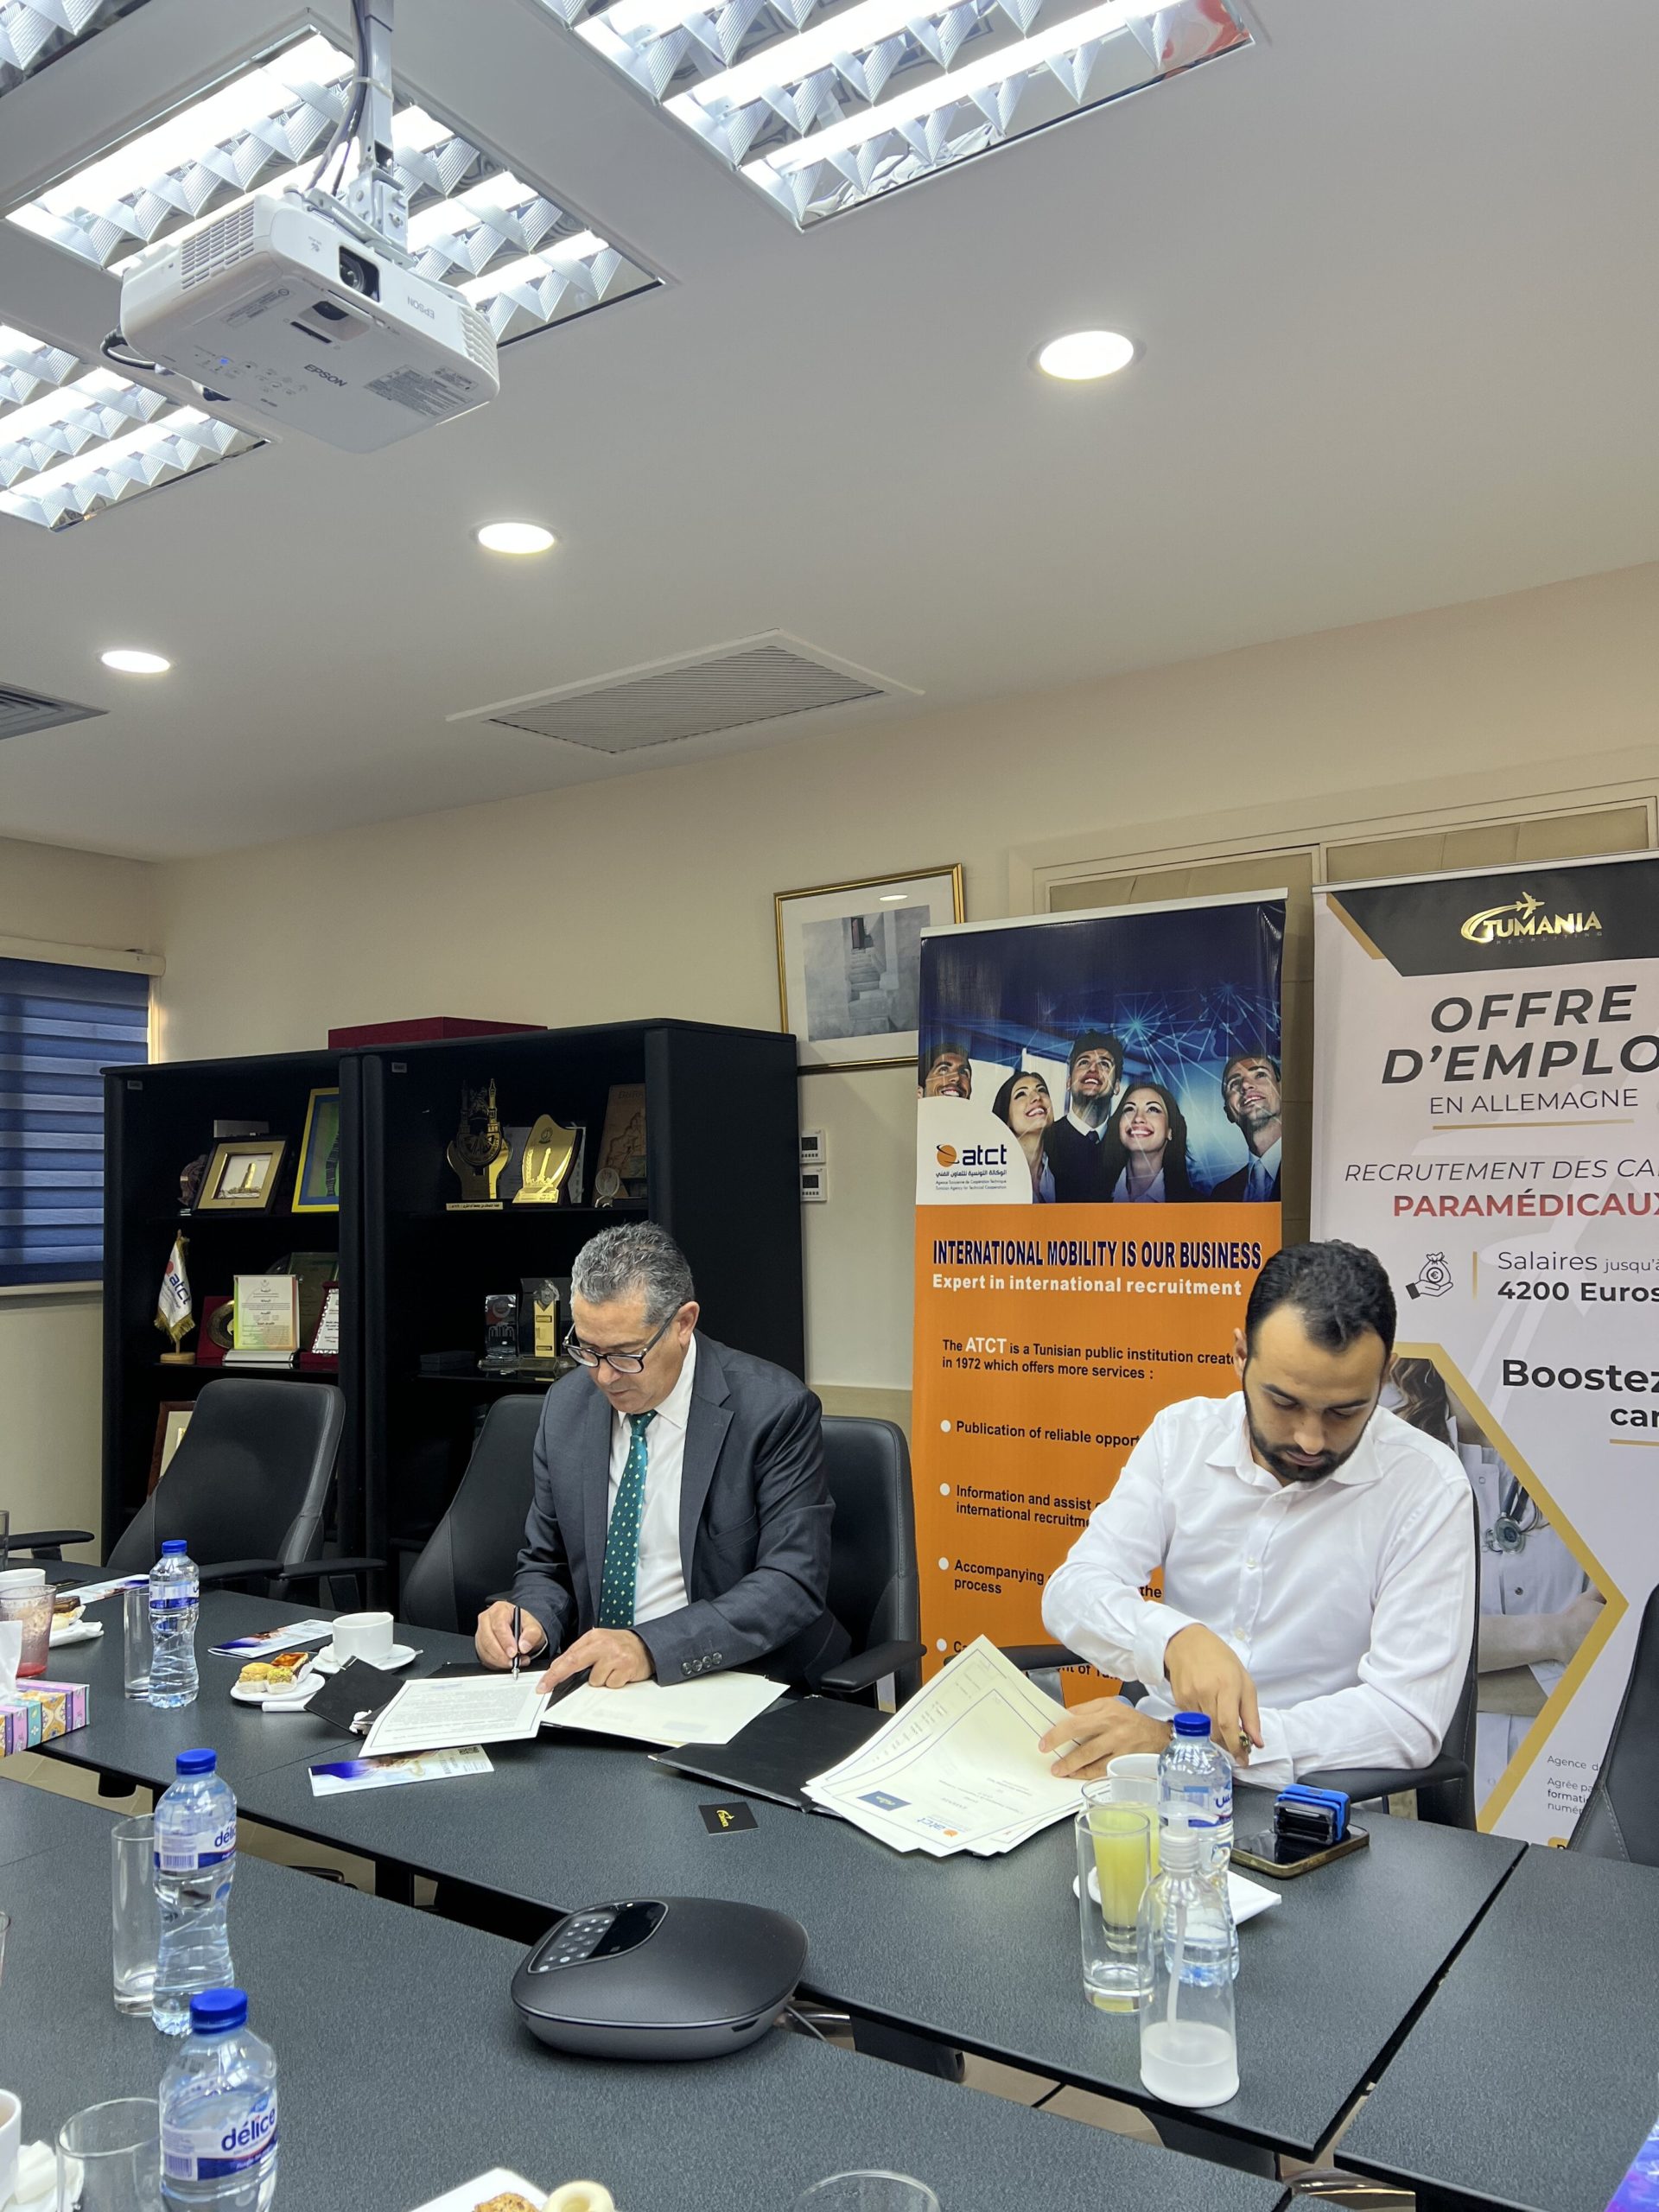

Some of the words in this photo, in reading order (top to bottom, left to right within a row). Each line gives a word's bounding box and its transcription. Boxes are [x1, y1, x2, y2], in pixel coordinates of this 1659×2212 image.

[407, 296, 435, 320] EPSON
[304, 364, 347, 387] EPSON
[1483, 911, 1602, 942] TUMANIA
[1497, 931, 1602, 944] RECRUITING
[1431, 984, 1637, 1033] OFFRE
[1430, 1096, 1463, 1115] EN
[1471, 1089, 1638, 1113] ALLEMAGNE
[963, 1144, 1007, 1166] atct
[1345, 1161, 1545, 1182] RECRUTEMENT
[1553, 1160, 1608, 1179] DES
[1618, 1159, 1659, 1177] CA
[933, 1240, 1043, 1265] INTERNATIONAL
[1047, 1241, 1116, 1267] MOBILITY
[1122, 1241, 1137, 1268] IS
[1141, 1241, 1175, 1268] OUR
[1180, 1242, 1262, 1269] BUSINESS
[1497, 1251, 1597, 1271] Salaires
[933, 1274, 985, 1292] Expert
[989, 1275, 1005, 1289] in
[1009, 1275, 1122, 1293] international
[1127, 1278, 1242, 1296] recruitment
[1497, 1281, 1569, 1301] 4200
[1581, 1282, 1659, 1302] Euros
[943, 1339, 963, 1351] The
[965, 1337, 1007, 1353] ATCT
[1009, 1343, 1020, 1354] is
[1023, 1345, 1029, 1355] a
[1033, 1343, 1081, 1357] Tunisian
[1085, 1346, 1123, 1360] public
[1127, 1347, 1193, 1363] institution
[943, 1357, 952, 1368] in
[956, 1357, 981, 1370] 1972
[984, 1359, 1018, 1372] which
[1022, 1361, 1054, 1374] offers
[1058, 1363, 1088, 1376] more
[1092, 1366, 1145, 1379] services
[957, 1421, 1026, 1438] Publication
[1029, 1427, 1041, 1439] of
[1045, 1428, 1091, 1444] reliable
[957, 1484, 1025, 1503] Information
[1028, 1494, 1050, 1507] and
[1053, 1497, 1091, 1510] assist
[956, 1502, 1031, 1522] international
[954, 1559, 1044, 1586] Accompanying
[1139, 1585, 1162, 1599] the
[954, 1578, 1002, 1594] process
[1548, 1755, 1586, 1769] Agence
[1592, 1763, 1600, 1771] d
[1548, 1777, 1578, 1790] Agrée
[1548, 1789, 1588, 1803] formati
[214, 1826, 236, 1847] déli
[221, 2108, 276, 2152] délice
